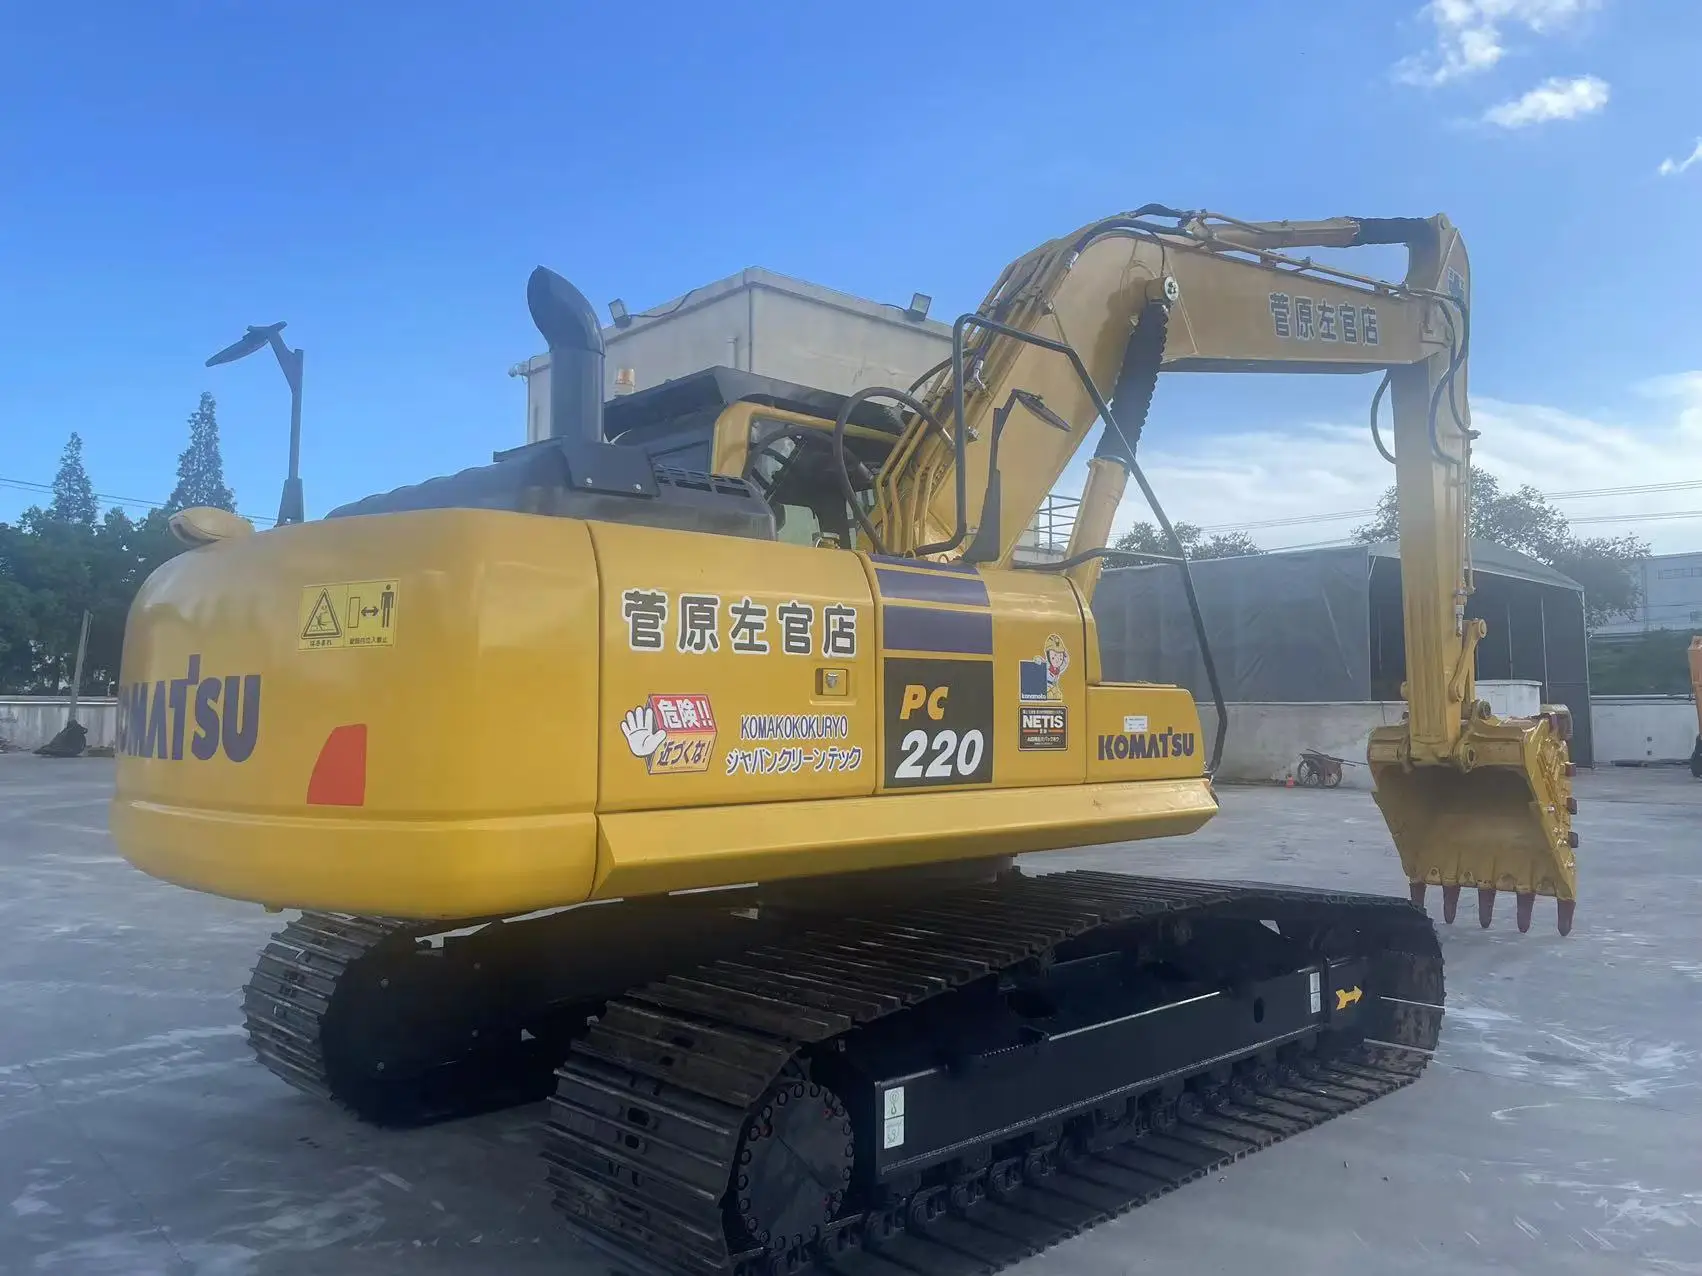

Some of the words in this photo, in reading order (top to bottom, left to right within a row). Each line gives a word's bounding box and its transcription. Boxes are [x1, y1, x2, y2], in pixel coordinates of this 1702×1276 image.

[1269, 291, 1379, 346] 菅原左官店
[622, 588, 857, 658] 菅原左官店
[657, 698, 713, 729] 危険!!
[900, 684, 949, 720] PC
[741, 715, 848, 739] KOMAKOKOKURYO
[1022, 715, 1064, 728] NETIS
[656, 739, 712, 767] 近づくな!
[894, 729, 984, 778] 220
[1098, 726, 1195, 761] KOMATSU
